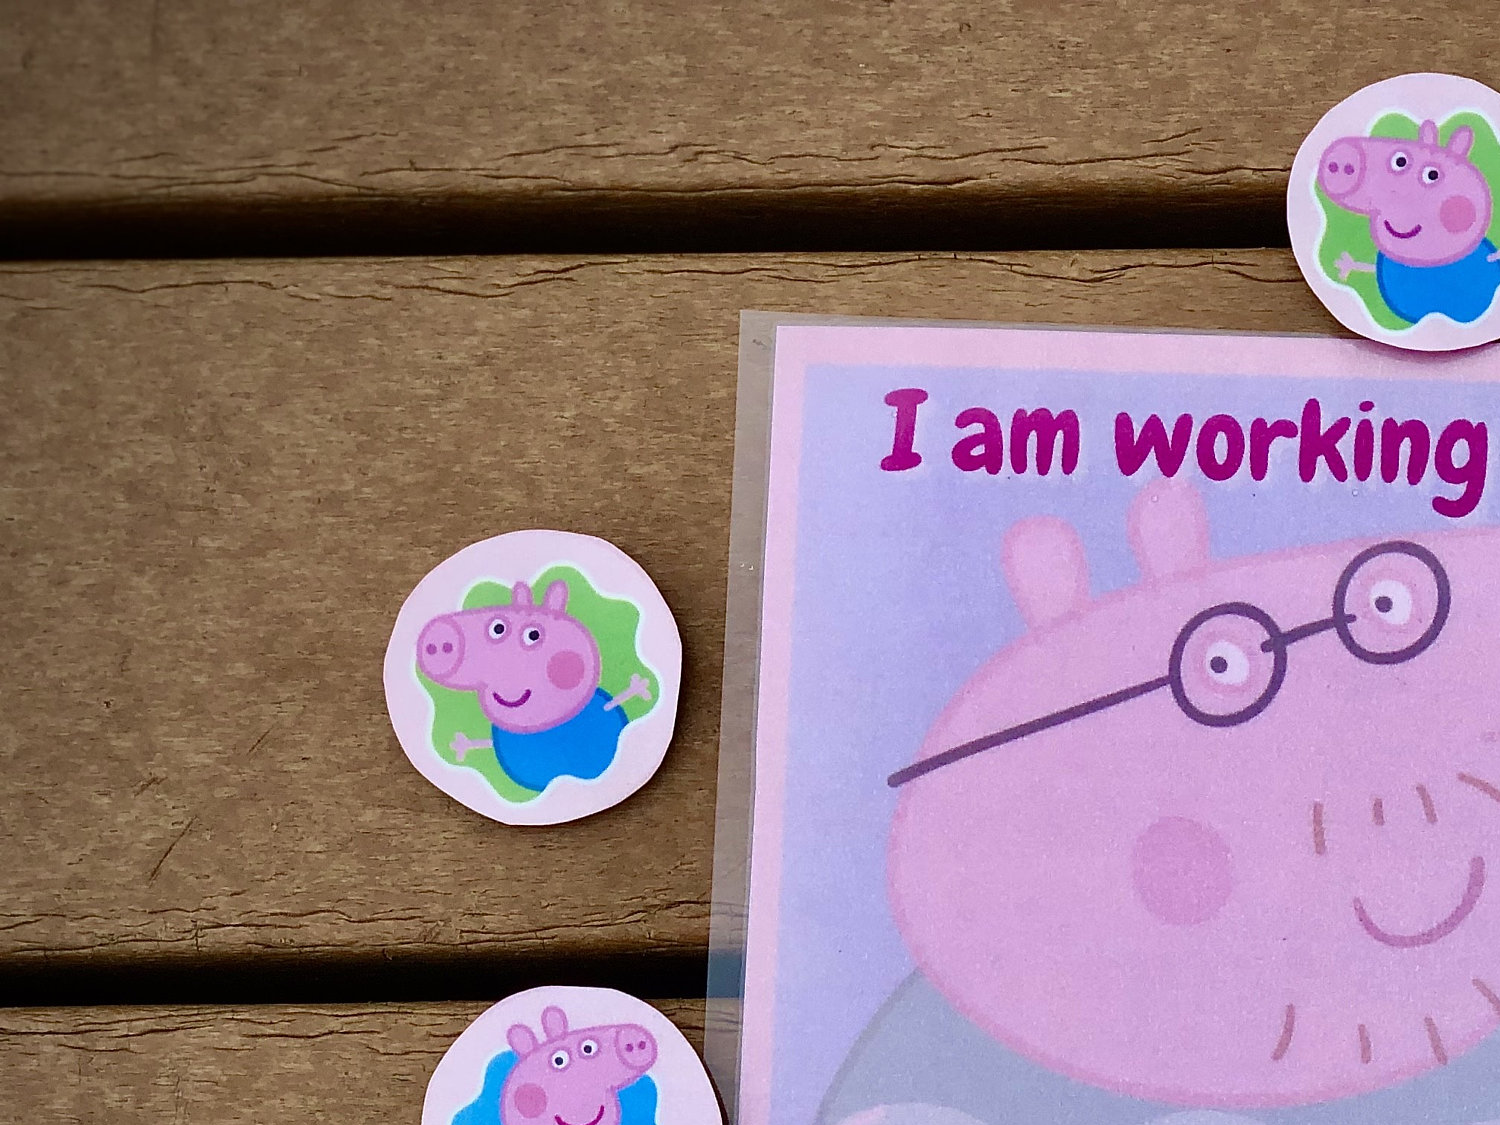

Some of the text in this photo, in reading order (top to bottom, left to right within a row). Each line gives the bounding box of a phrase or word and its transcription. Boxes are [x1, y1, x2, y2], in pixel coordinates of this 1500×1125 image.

[880, 388, 929, 472] I
[951, 407, 1080, 477] am
[1114, 397, 1489, 519] working
